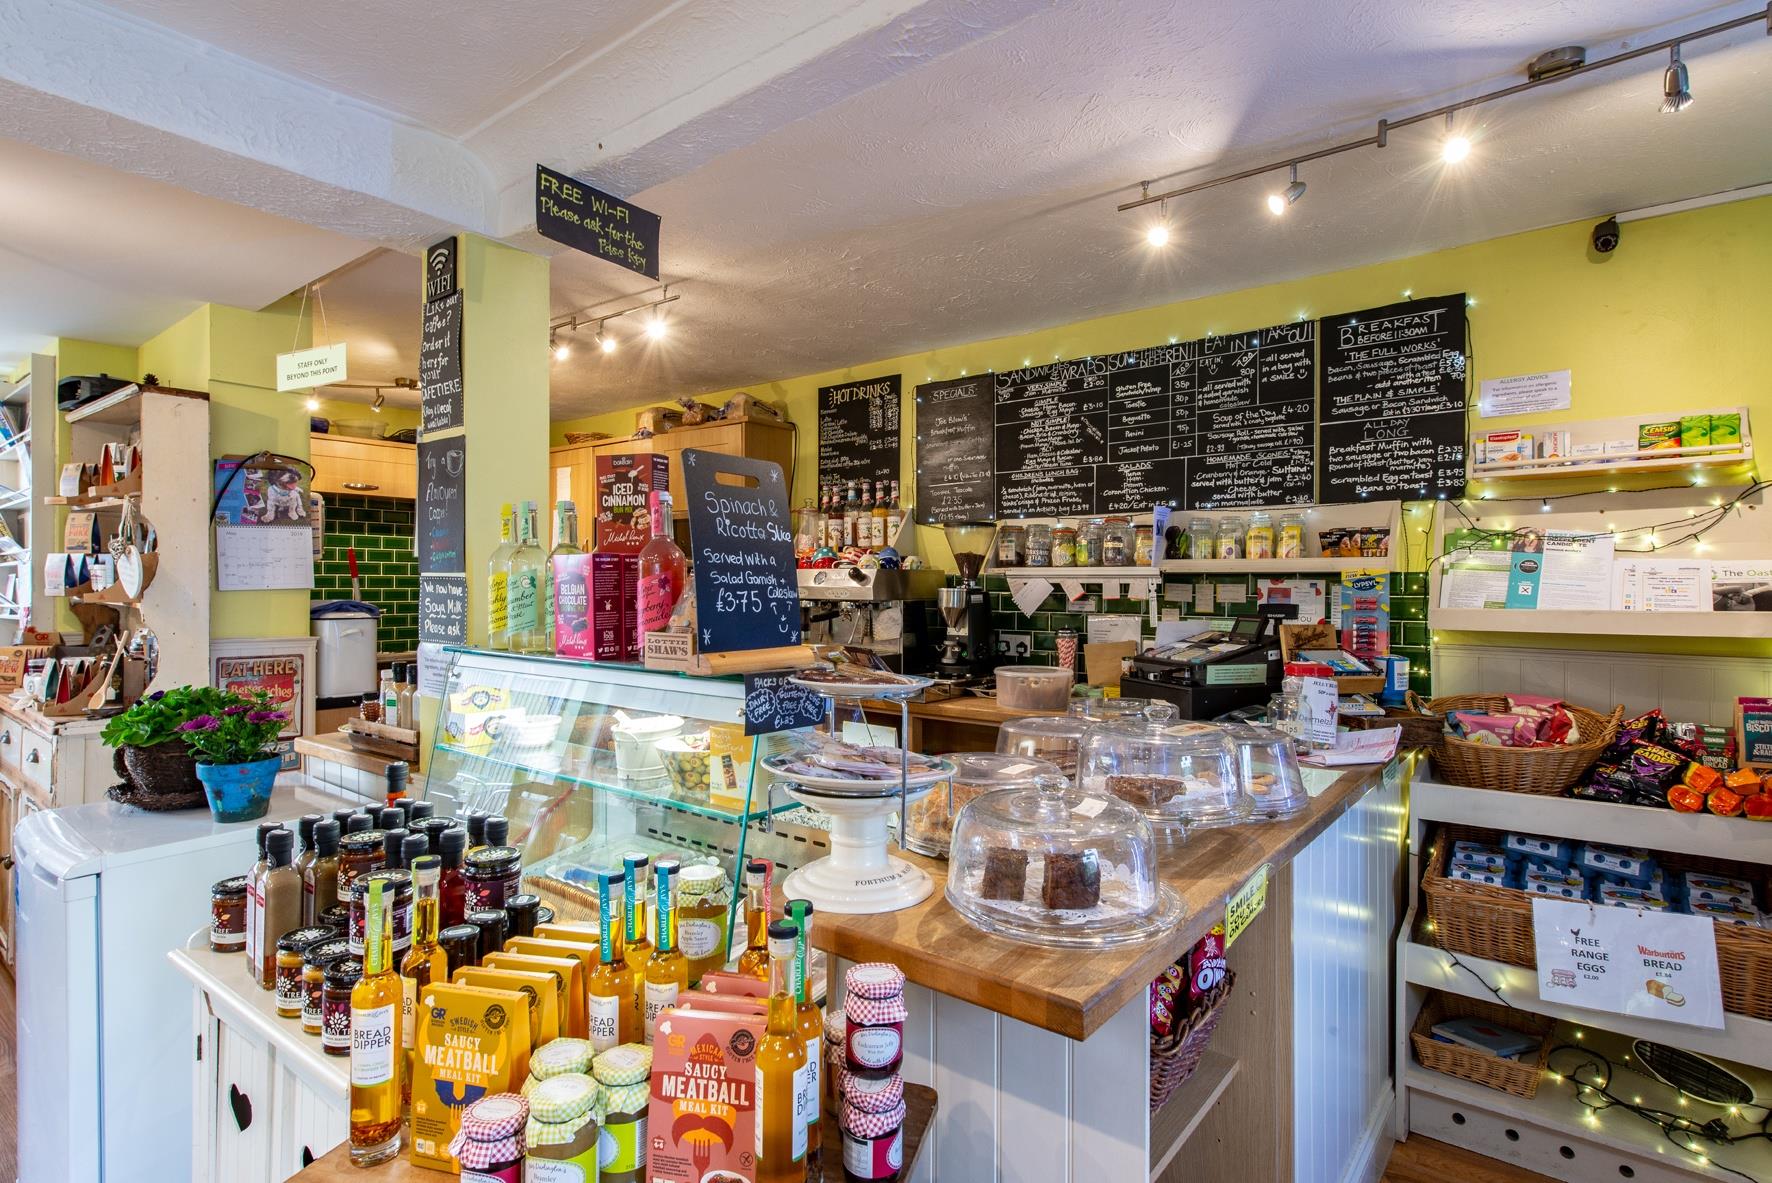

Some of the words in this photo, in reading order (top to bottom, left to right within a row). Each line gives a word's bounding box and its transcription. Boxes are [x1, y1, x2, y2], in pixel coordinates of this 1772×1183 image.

[541, 174, 583, 204] FREE
[592, 196, 629, 224] WI-FI
[541, 197, 581, 224] Please
[584, 218, 604, 234] ask
[427, 274, 452, 296] WIFI
[446, 294, 459, 308] our
[1340, 311, 1439, 348] BREAKFAST
[1231, 335, 1246, 352] IN
[1357, 333, 1393, 344] BEFORE
[1372, 346, 1398, 357] FULL
[297, 361, 312, 369] STAFF
[314, 358, 328, 366] ONLY
[1059, 356, 1106, 379] WRAPS
[286, 372, 309, 380] BEYOND
[323, 366, 338, 374] POINT
[422, 369, 441, 387] your
[1270, 374, 1295, 382] SMILE
[833, 389, 852, 405] HOT
[853, 382, 891, 400] DRINKS
[1354, 392, 1382, 401] PLAIN
[1331, 404, 1370, 416] Sausage
[1381, 401, 1407, 409] Bacon
[1408, 395, 1448, 405] Sandwich
[1212, 413, 1233, 423] Soup
[1245, 409, 1258, 418] the
[1364, 421, 1388, 430] ALL
[1390, 418, 1411, 427] DAY
[1364, 427, 1409, 441] LONG
[1329, 443, 1376, 455] Breakfast
[1377, 441, 1409, 450] Muffin
[1412, 438, 1432, 446] with
[1206, 453, 1251, 463] HOMEMADE
[1345, 452, 1382, 463] sausage
[1191, 479, 1215, 487] served
[1330, 474, 1380, 484] Scrambled
[1382, 474, 1399, 484] Egg
[1410, 471, 1433, 479] toast
[613, 483, 633, 495] ICED
[1355, 484, 1383, 493] Beans
[1397, 481, 1428, 490] toast
[602, 494, 645, 507] CINNAMON
[704, 491, 767, 520] Spinach
[768, 500, 778, 517] &
[716, 517, 766, 540] Ricotta
[766, 523, 792, 543] Slice
[703, 548, 744, 566] Served
[769, 556, 777, 566] a
[710, 571, 744, 585] Salad
[1353, 580, 1378, 589] LYPSYL
[560, 583, 585, 595] BELGIAN
[425, 599, 446, 616] Soya
[558, 595, 587, 606] CHOCOLATE
[424, 620, 445, 635] Please
[647, 644, 688, 656] SHAW'S
[221, 662, 248, 678] EAT
[253, 659, 297, 676] HERE
[754, 678, 776, 688] PACKS
[1647, 746, 1678, 760] SPACE
[1704, 761, 1728, 769] BREAD
[855, 874, 897, 887] FORTNUM
[1230, 885, 1255, 917] SMILE
[1575, 936, 1600, 948] FREE
[1571, 948, 1610, 962] RANGE
[1576, 962, 1607, 974] EGGS
[1643, 958, 1683, 972] BREAD
[354, 1026, 391, 1040] BREAD
[353, 1036, 391, 1050] DIPPER
[444, 1033, 481, 1050] SAUCY
[424, 1045, 499, 1076] MEATBALL
[439, 1068, 463, 1080] MEAL
[465, 1073, 481, 1084] KIT
[685, 1062, 728, 1080] SAUCY
[662, 1074, 750, 1106] MEATBALL
[679, 1100, 707, 1113] MEAL
[710, 1103, 729, 1116] KIT
